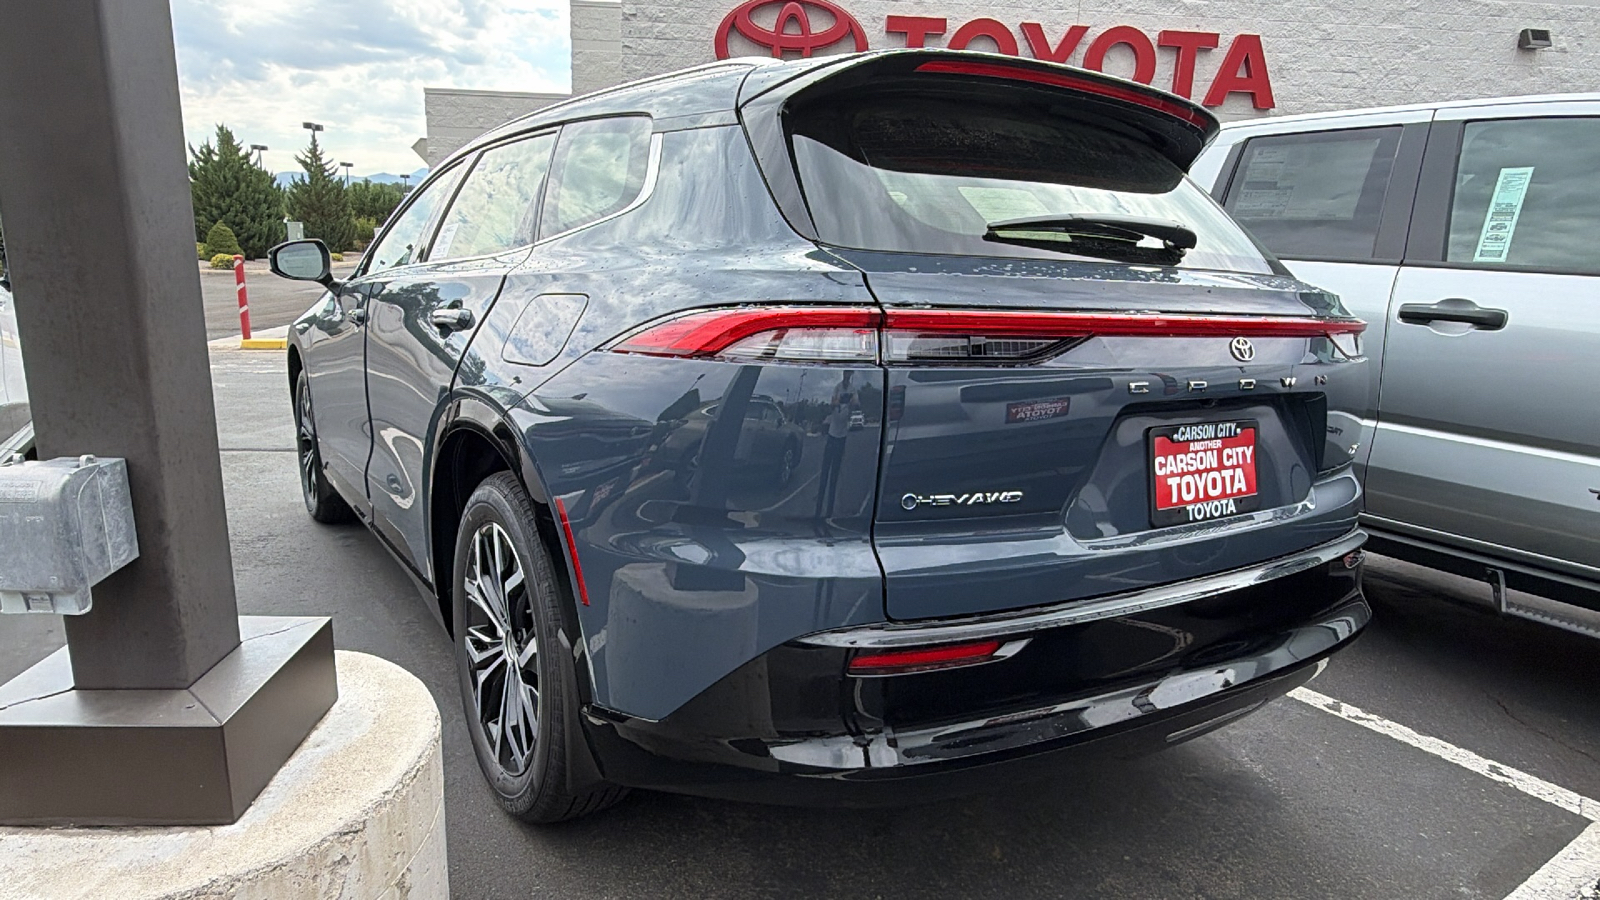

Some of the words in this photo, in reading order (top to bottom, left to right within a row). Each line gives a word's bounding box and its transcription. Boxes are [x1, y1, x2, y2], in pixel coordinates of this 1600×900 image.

[1128, 374, 1328, 394] CROWN
[1178, 425, 1215, 441] CARSON
[1217, 423, 1237, 437] CITY
[1189, 439, 1222, 451] ANOTHER
[1155, 450, 1218, 476] CARSON
[1222, 446, 1253, 467] CITY
[1167, 468, 1247, 504] TOYOTA
[1186, 498, 1237, 521] TOYOTA
